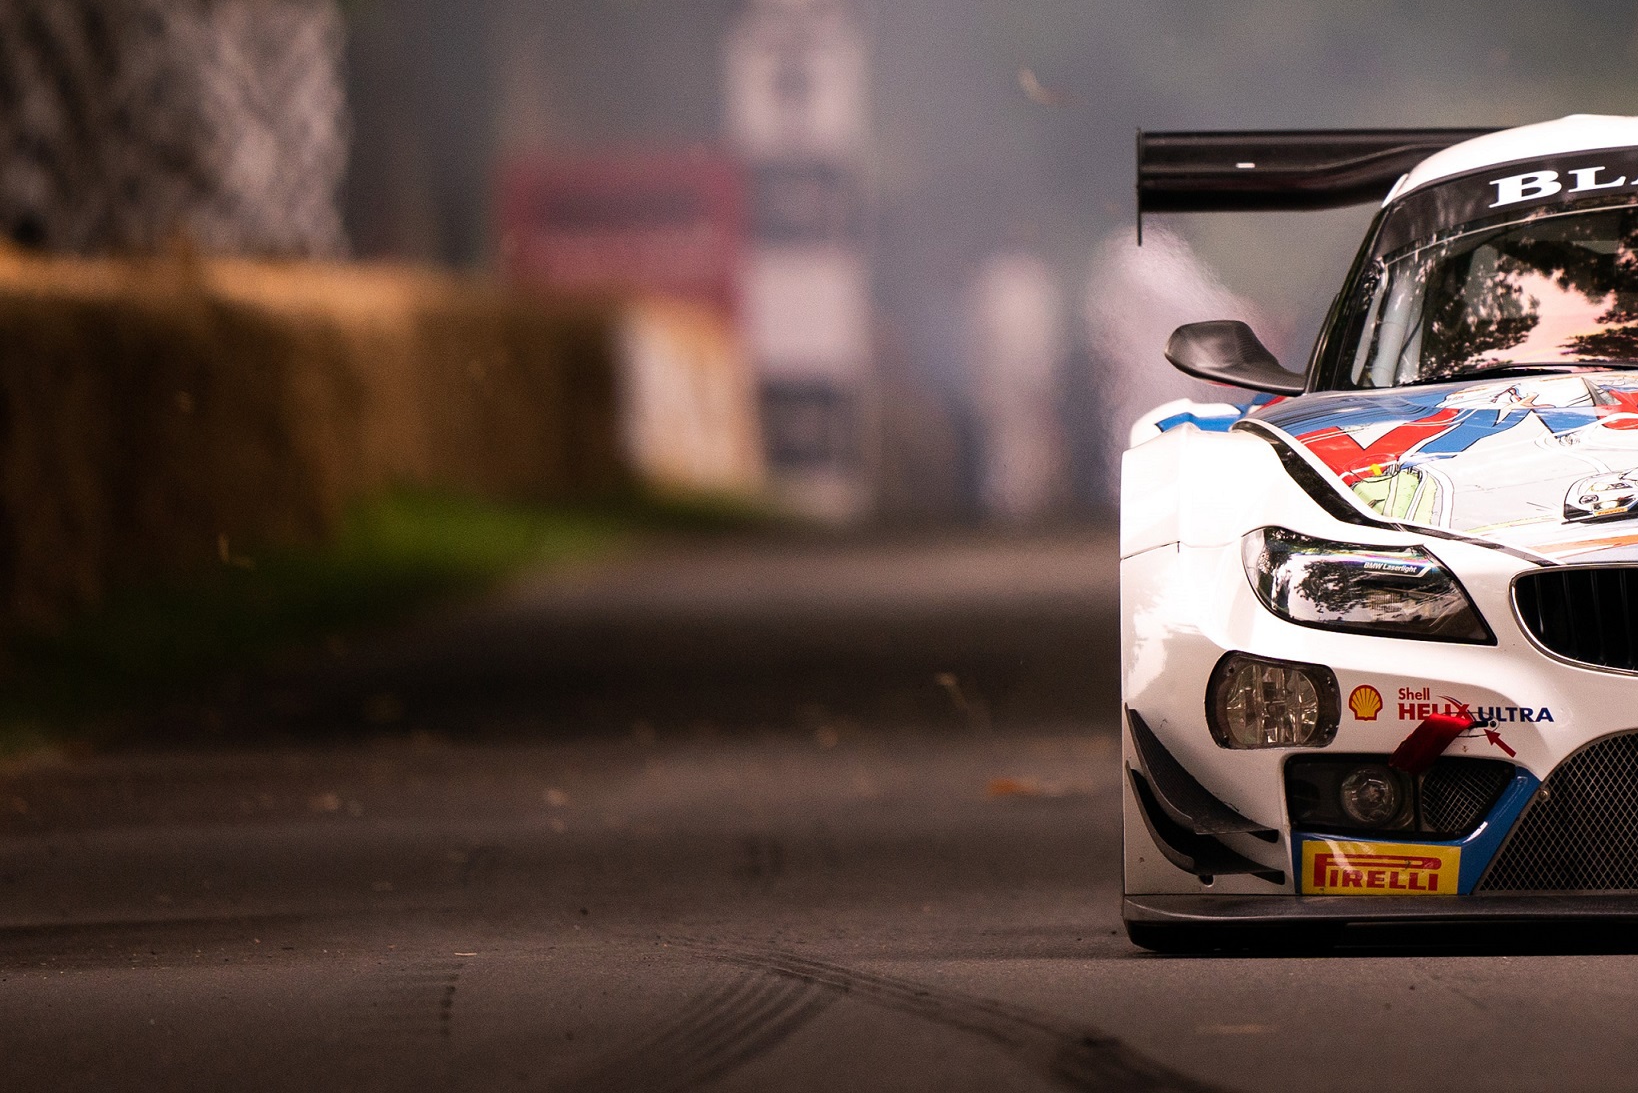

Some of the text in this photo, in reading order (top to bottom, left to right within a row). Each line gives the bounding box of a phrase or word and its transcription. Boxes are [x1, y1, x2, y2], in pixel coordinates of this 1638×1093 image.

[1363, 561, 1418, 573] BMW Laserlight
[1398, 687, 1430, 701] Shell
[1477, 706, 1555, 723] ULTRA
[1313, 853, 1442, 892] PIRELLI
